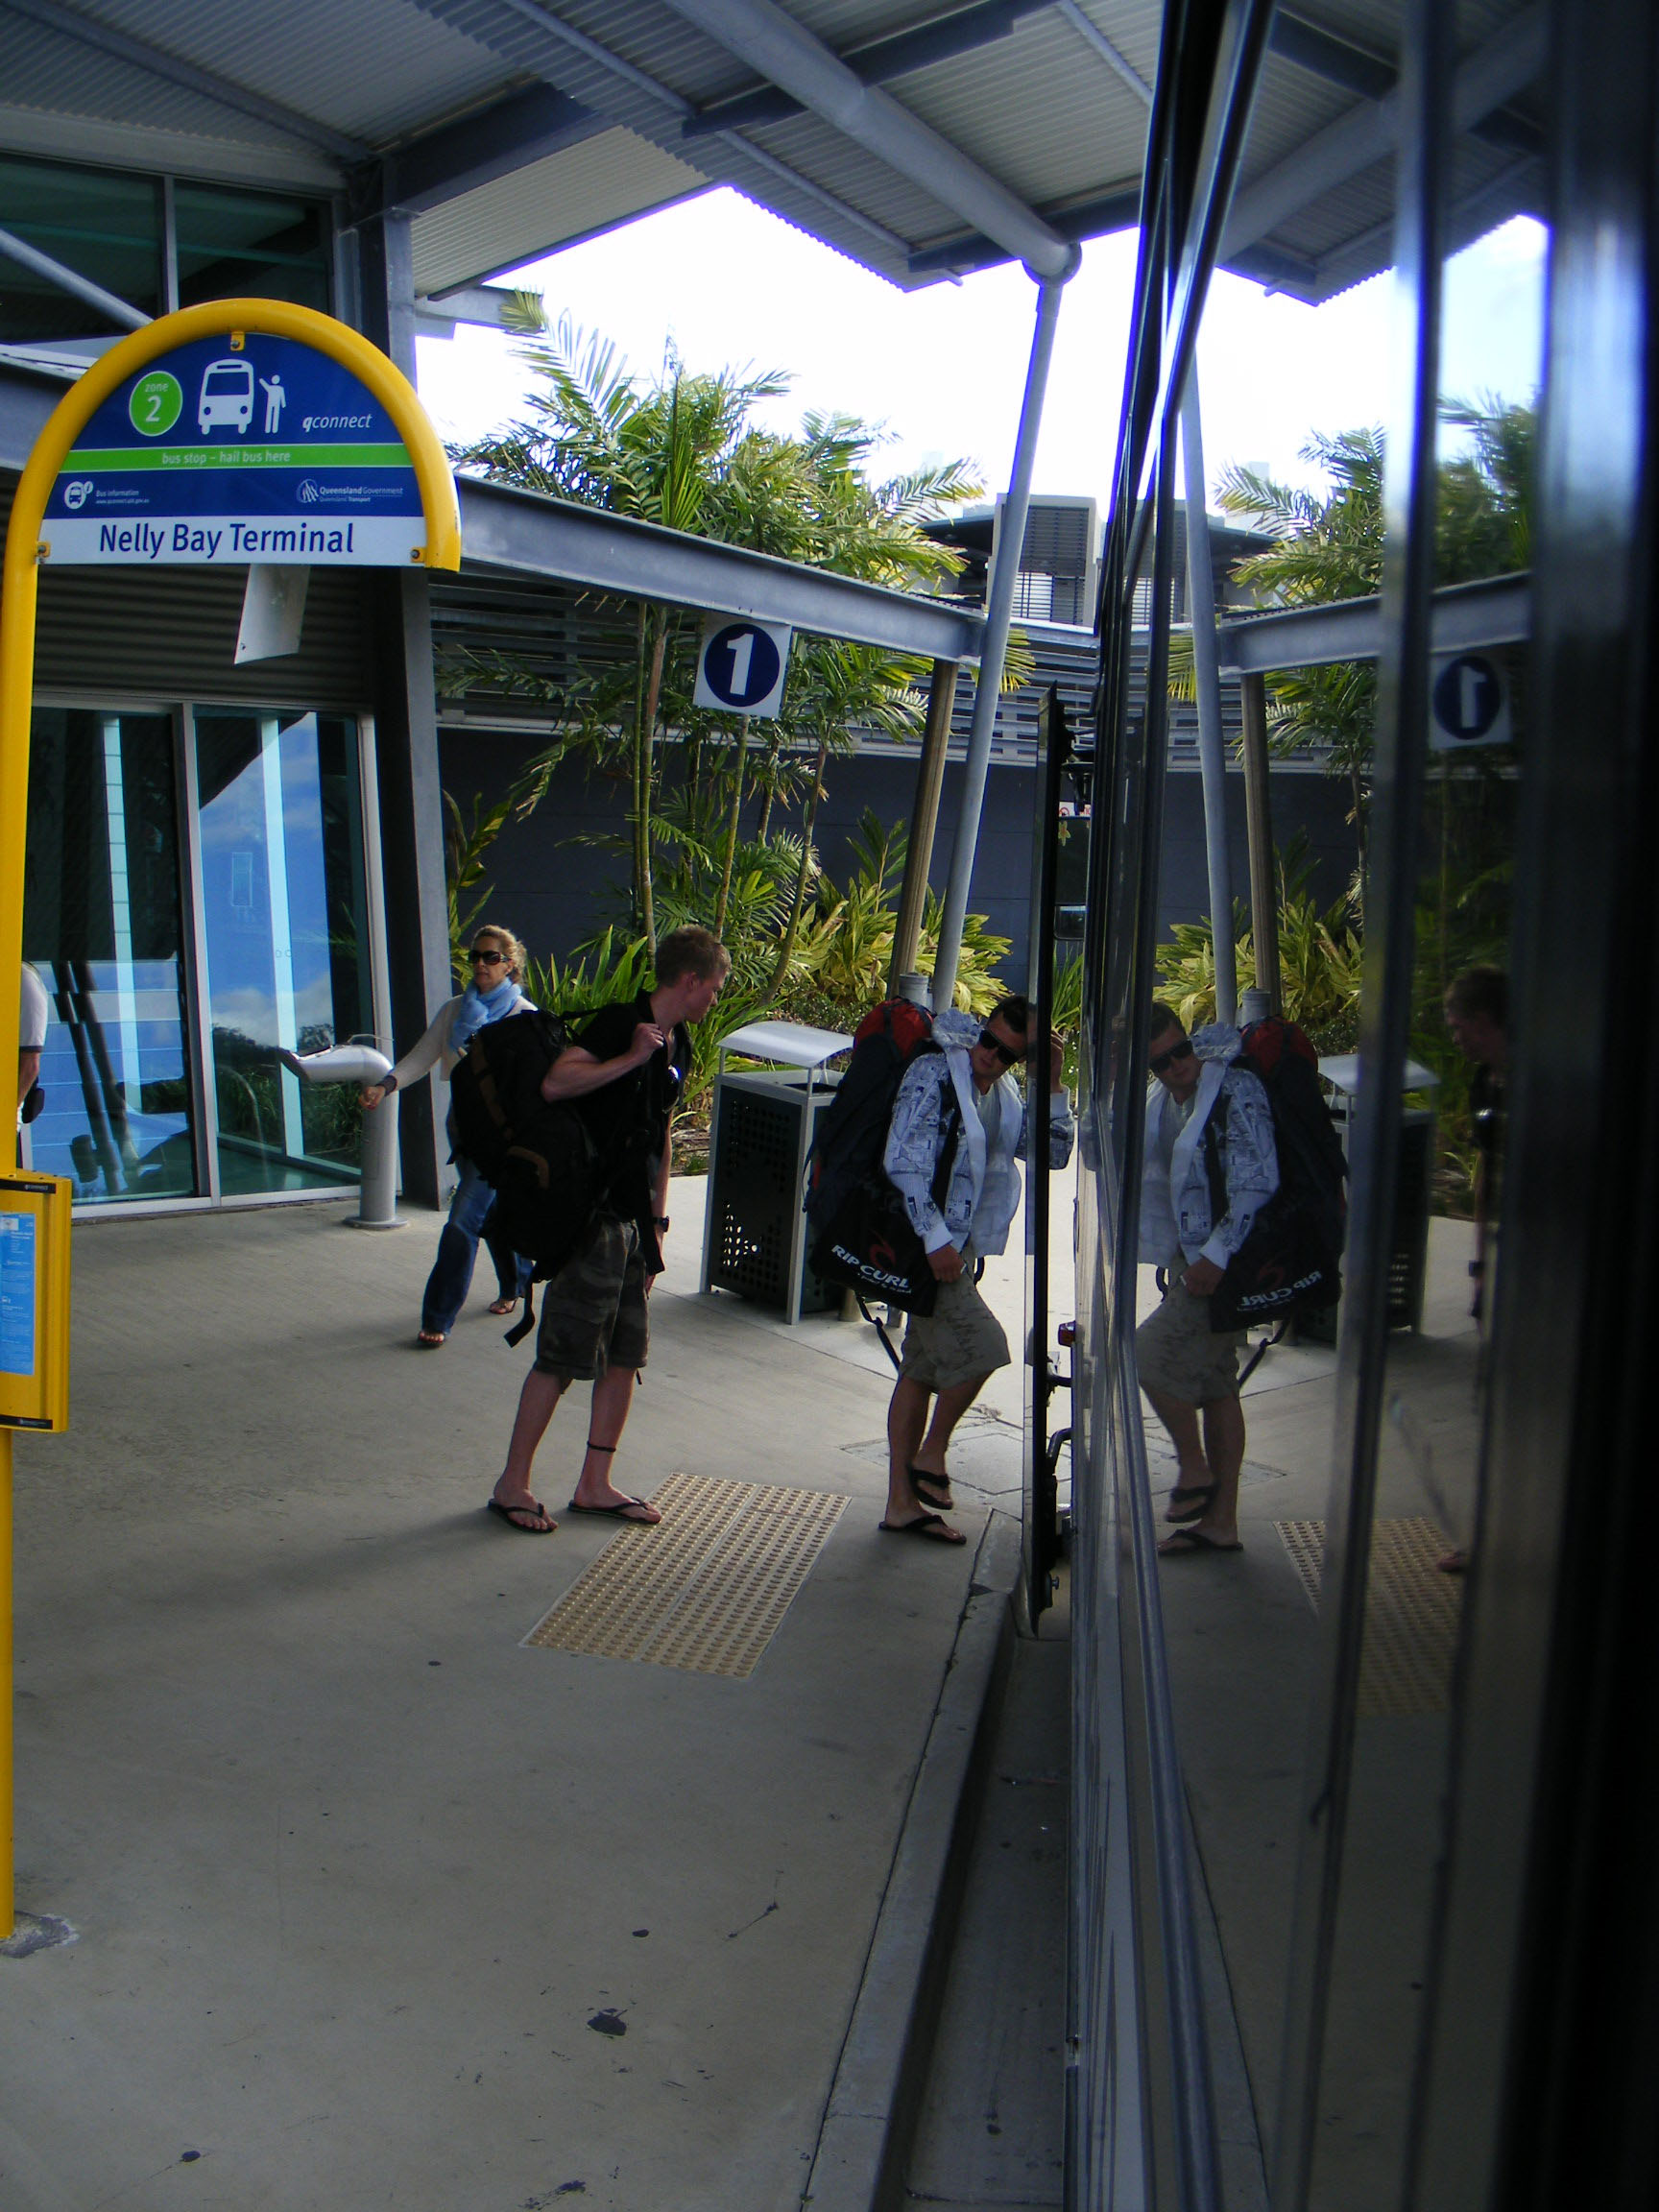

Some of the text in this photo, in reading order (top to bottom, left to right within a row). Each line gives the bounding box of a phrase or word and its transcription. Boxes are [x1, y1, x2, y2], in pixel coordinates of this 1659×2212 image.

[145, 382, 169, 393] zone
[145, 395, 162, 422] 2
[302, 413, 373, 432] qconnect
[162, 452, 180, 464] bus
[183, 453, 206, 466] stop
[219, 451, 240, 463] hail
[243, 451, 263, 462] bus
[265, 450, 291, 462] here
[320, 487, 362, 495] Queensland
[99, 522, 354, 559] Nelly Bay Terminal
[727, 633, 754, 696] 1
[831, 1244, 860, 1265] RIP
[860, 1265, 909, 1288] CURL
